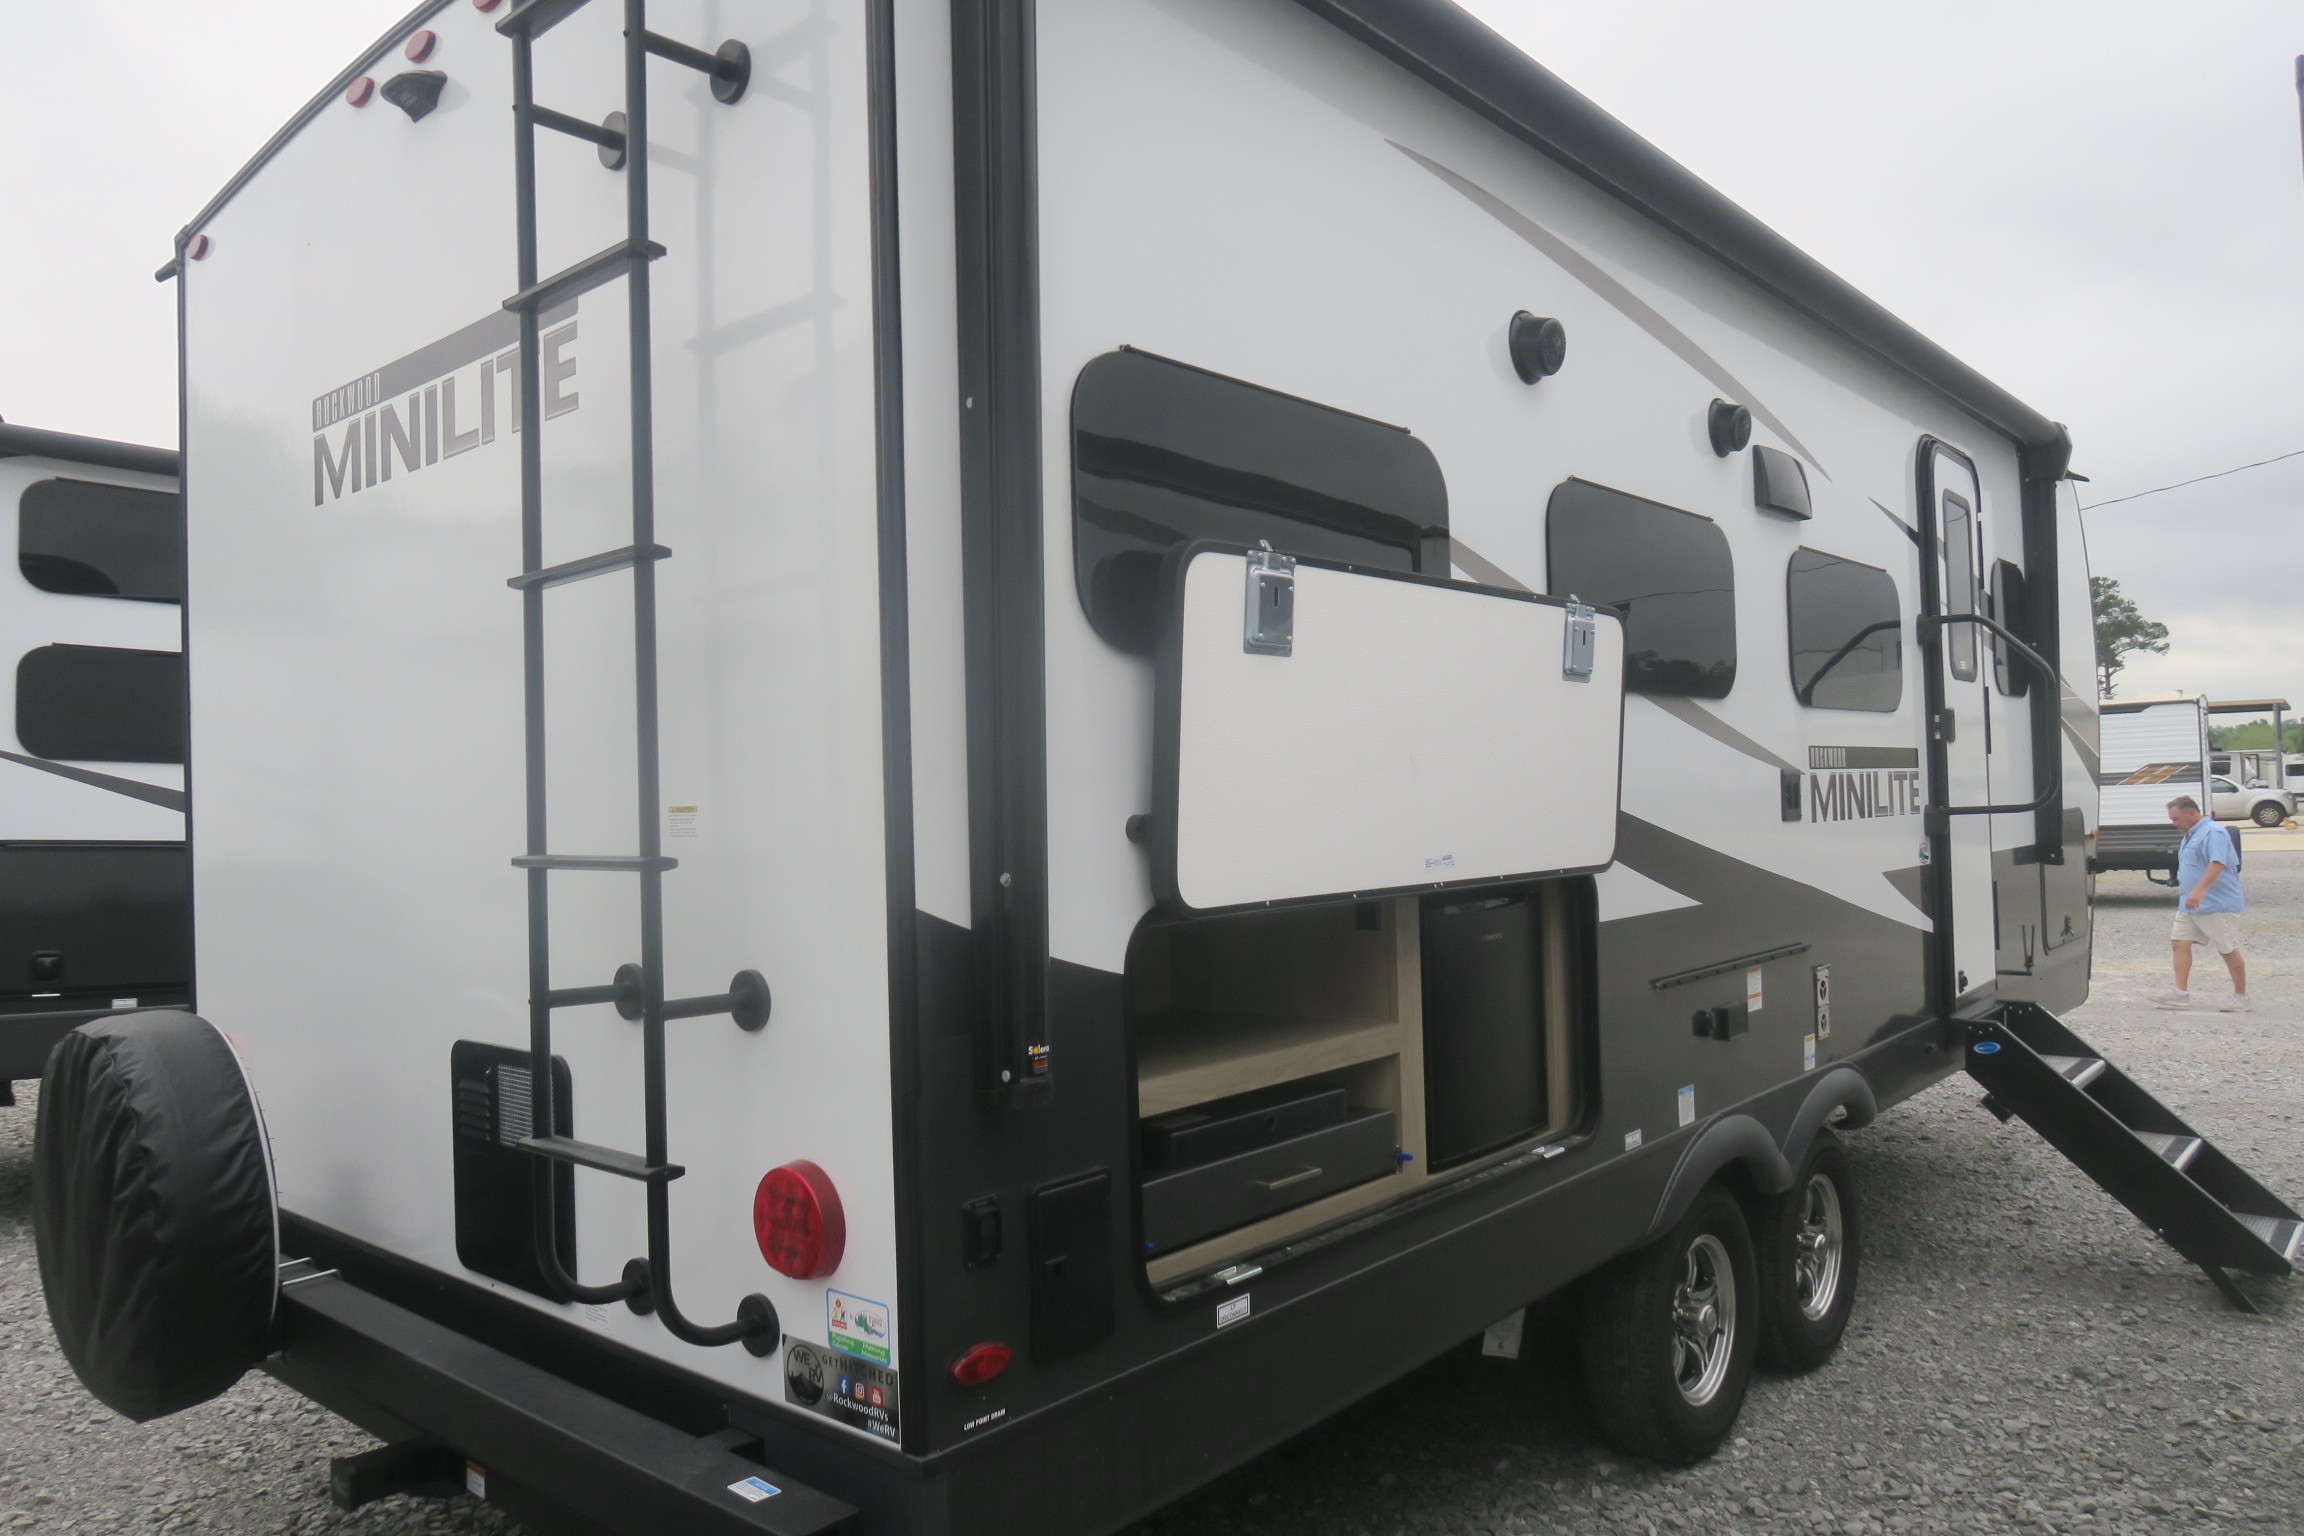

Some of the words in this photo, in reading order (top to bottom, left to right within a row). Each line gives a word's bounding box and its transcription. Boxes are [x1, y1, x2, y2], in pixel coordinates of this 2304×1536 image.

[315, 371, 381, 429] ROCKWOOD
[314, 320, 580, 507] MINILITE
[1810, 770, 1921, 824] MINILITE
[793, 1349, 810, 1366] WE
[808, 1366, 823, 1383] RV
[826, 1392, 889, 1422] @RockwoodRVs
[964, 1420, 975, 1431] LOW
[976, 1415, 990, 1426] POINT
[991, 1408, 1006, 1420] DRAIN
[867, 1420, 896, 1438] #WeRV
